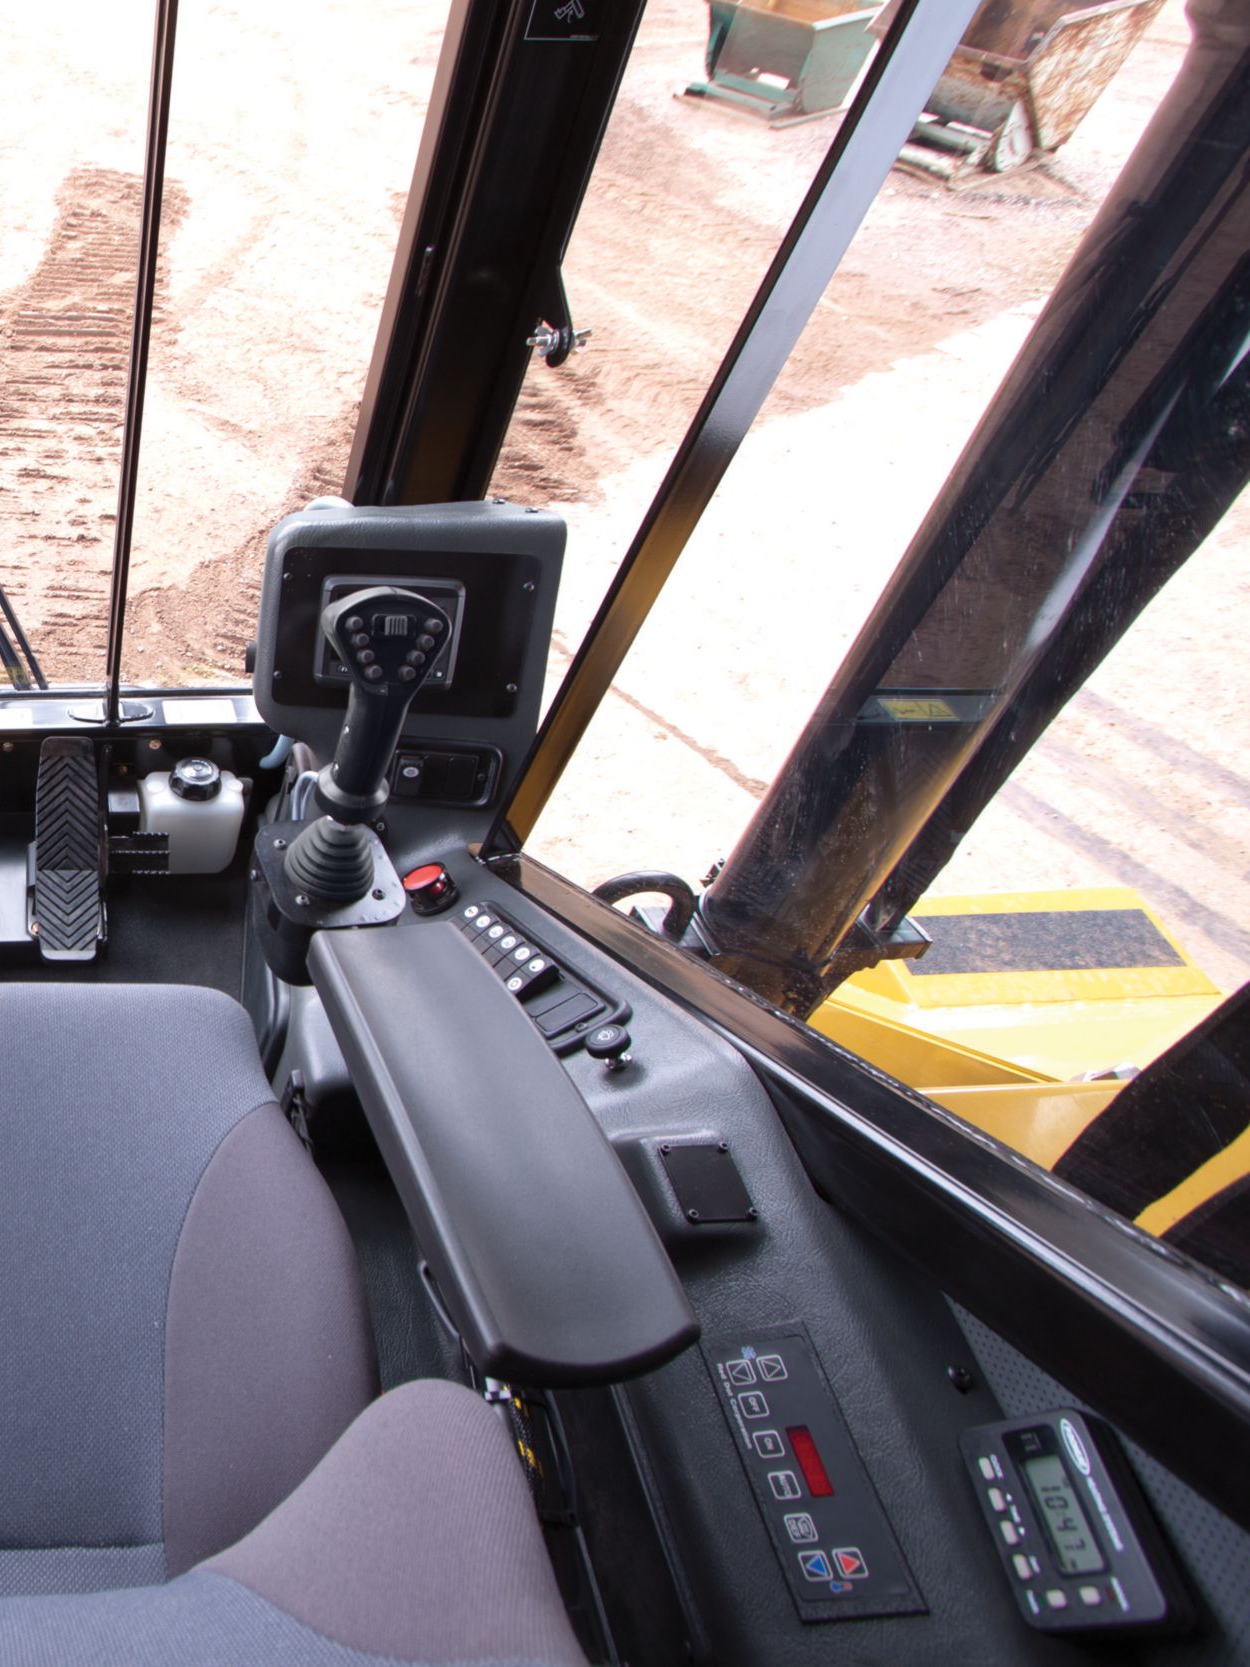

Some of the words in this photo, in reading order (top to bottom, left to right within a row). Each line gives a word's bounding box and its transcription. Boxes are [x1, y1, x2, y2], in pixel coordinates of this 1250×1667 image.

[716, 1362, 727, 1380] Red
[724, 1381, 734, 1397] Dot
[730, 1398, 753, 1450] Corporation
[748, 1396, 761, 1413] OFF
[764, 1437, 775, 1451] ON
[778, 1473, 792, 1497] AUTO
[788, 1519, 801, 1538] DEF
